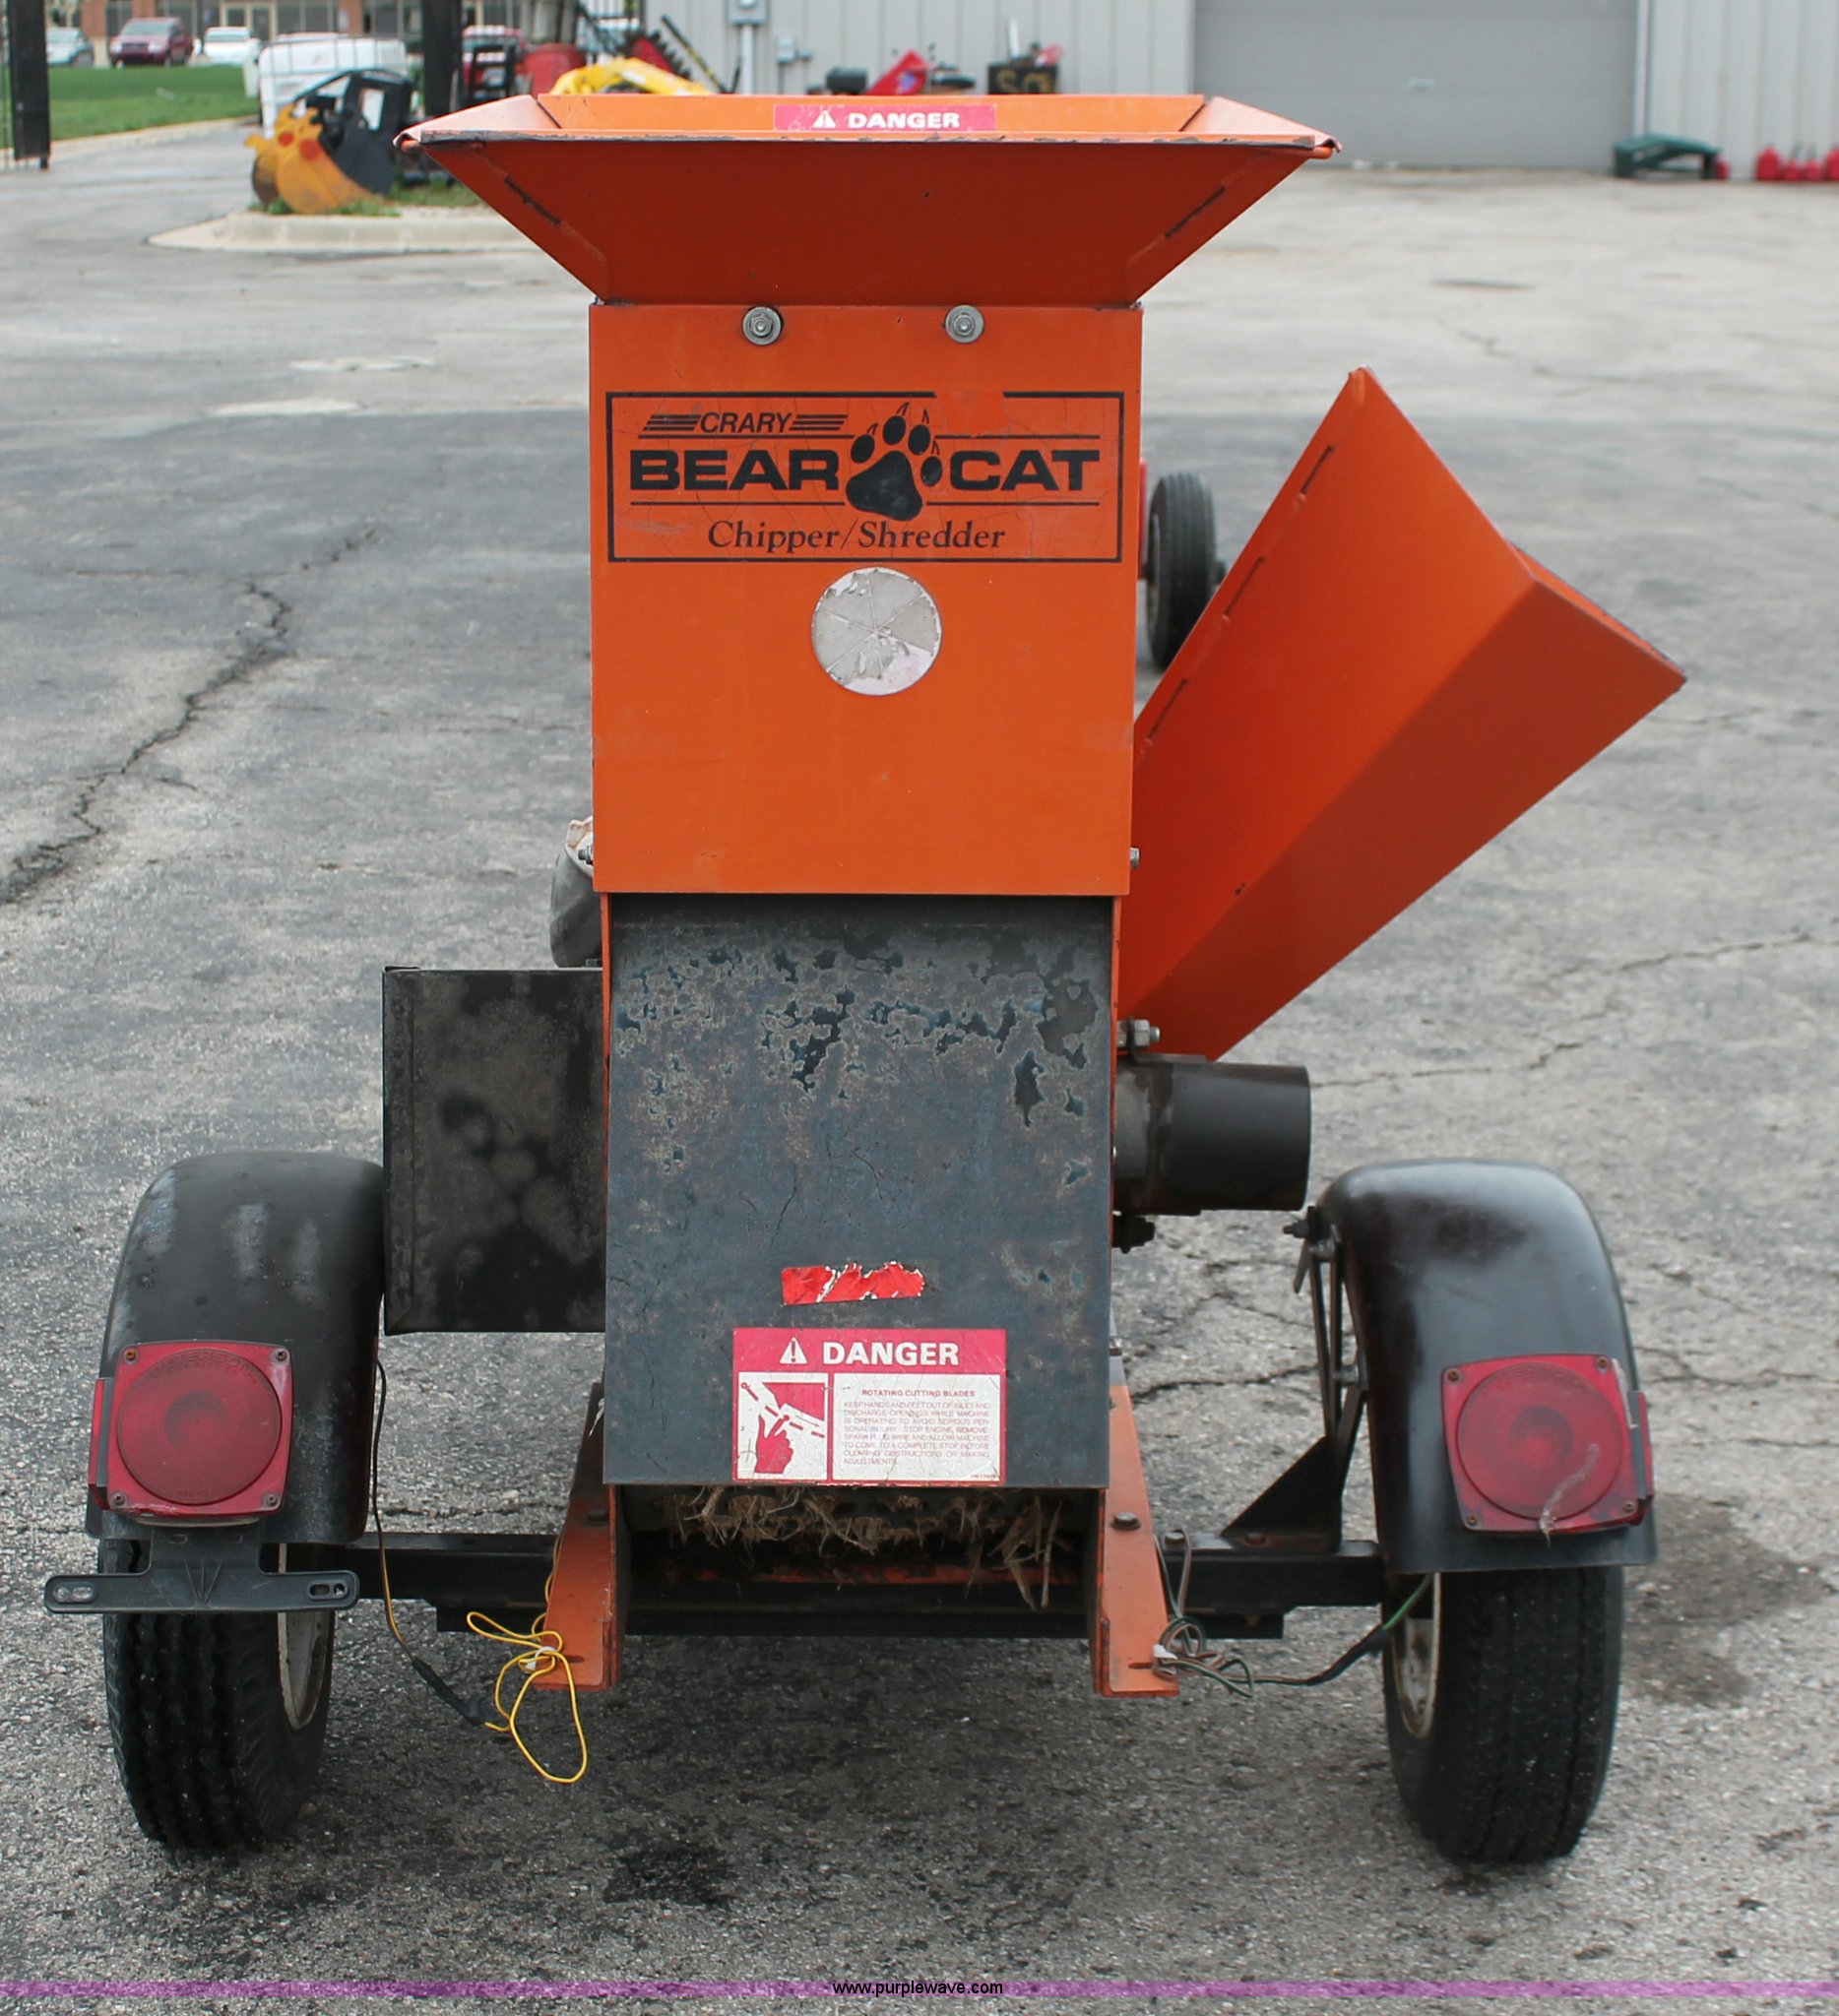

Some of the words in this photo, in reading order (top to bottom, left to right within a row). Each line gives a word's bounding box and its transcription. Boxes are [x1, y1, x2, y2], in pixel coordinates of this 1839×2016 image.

[848, 112, 960, 129] DANGER
[699, 411, 792, 433] CRARY
[630, 449, 839, 491] BEAR
[950, 449, 1101, 491] CAT
[708, 519, 1006, 554] Chipper/Shredder
[822, 1342, 960, 1365] DANGER
